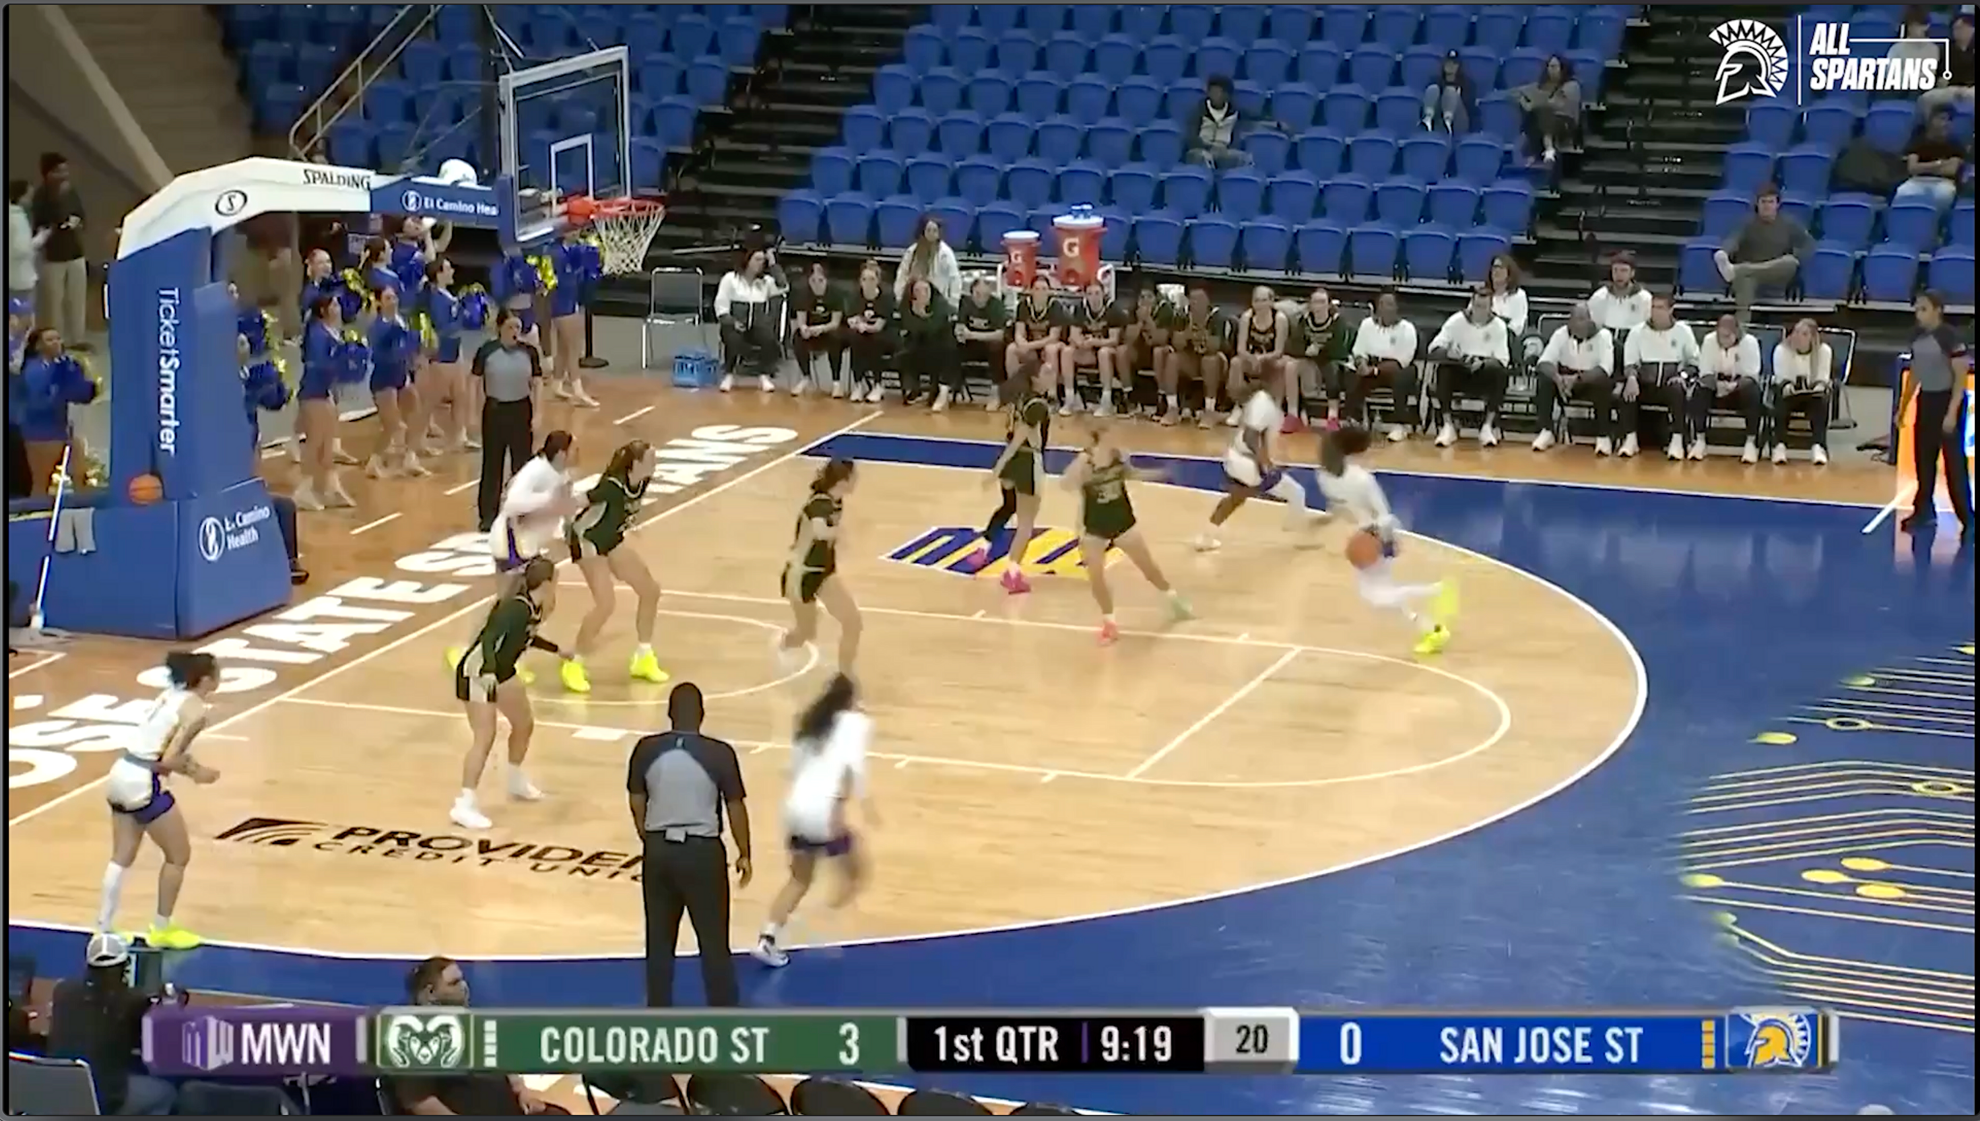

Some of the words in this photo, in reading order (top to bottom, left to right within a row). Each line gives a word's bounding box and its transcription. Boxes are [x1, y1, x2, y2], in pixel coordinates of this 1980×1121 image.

[303, 168, 371, 191] SPALDING
[436, 197, 476, 214] Camino
[477, 201, 499, 216] Hea
[1063, 237, 1080, 258] G
[158, 287, 181, 457] TicketSmarter
[226, 525, 259, 551] Health
